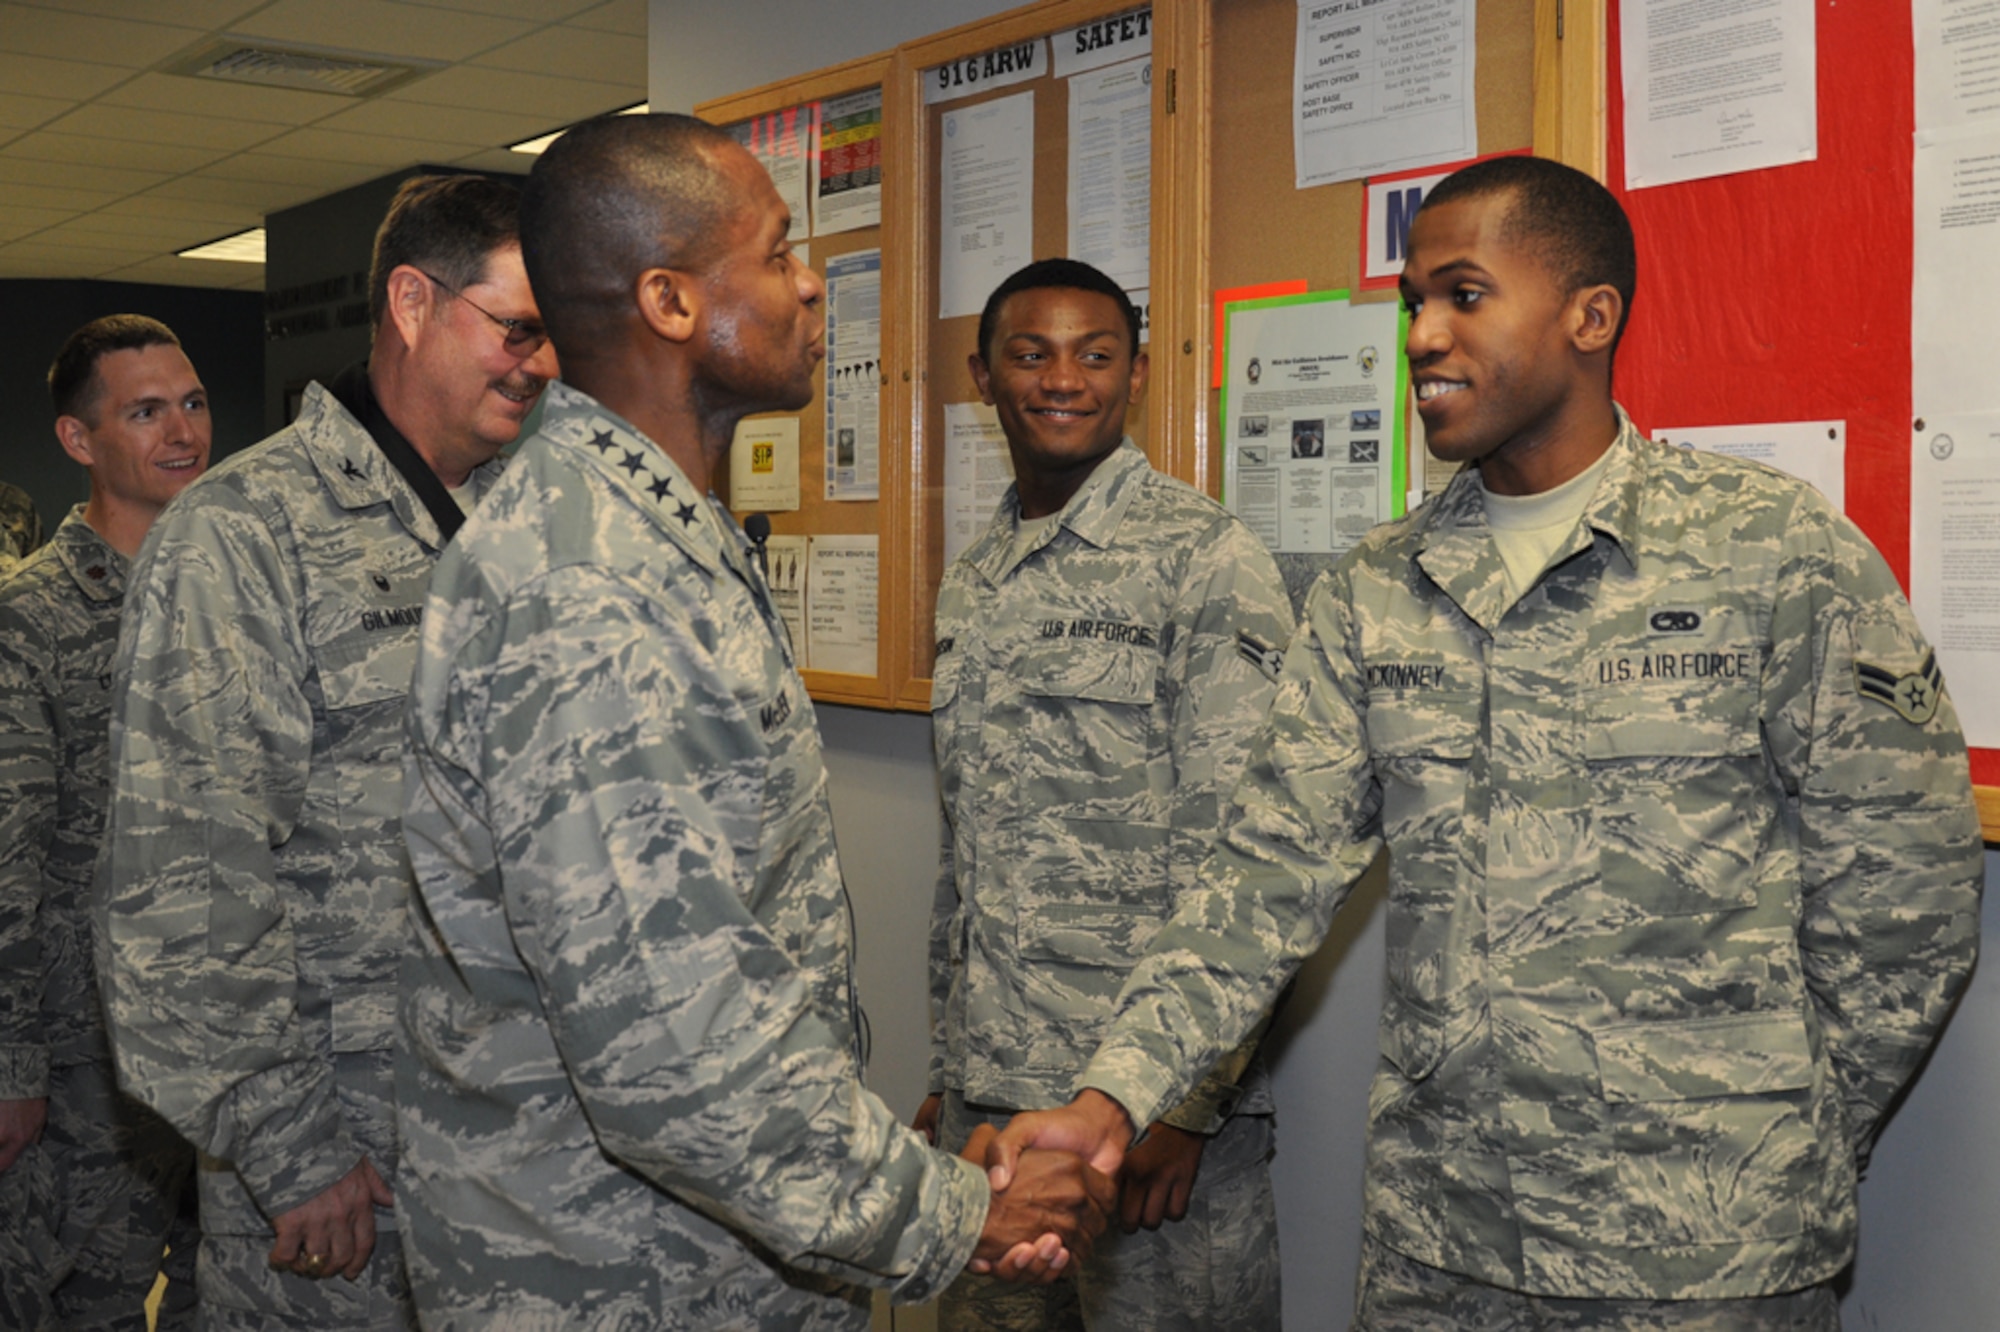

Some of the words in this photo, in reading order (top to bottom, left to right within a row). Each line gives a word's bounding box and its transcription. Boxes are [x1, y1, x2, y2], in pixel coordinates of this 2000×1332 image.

[1311, 4, 1343, 19] REPORT
[939, 59, 977, 88] 916
[983, 43, 1034, 79] ARW
[1319, 54, 1344, 66] SAFETY
[1303, 80, 1328, 92] SAFETY
[1330, 72, 1360, 85] OFFICER
[361, 607, 423, 631] GILMOU
[1068, 619, 1094, 638] AIR
[1094, 620, 1156, 647] FORCE
[1366, 663, 1445, 688] CKINNEY
[1599, 657, 1635, 684] U.S.
[1641, 653, 1676, 678] AIR
[1681, 652, 1750, 678] FORCE
